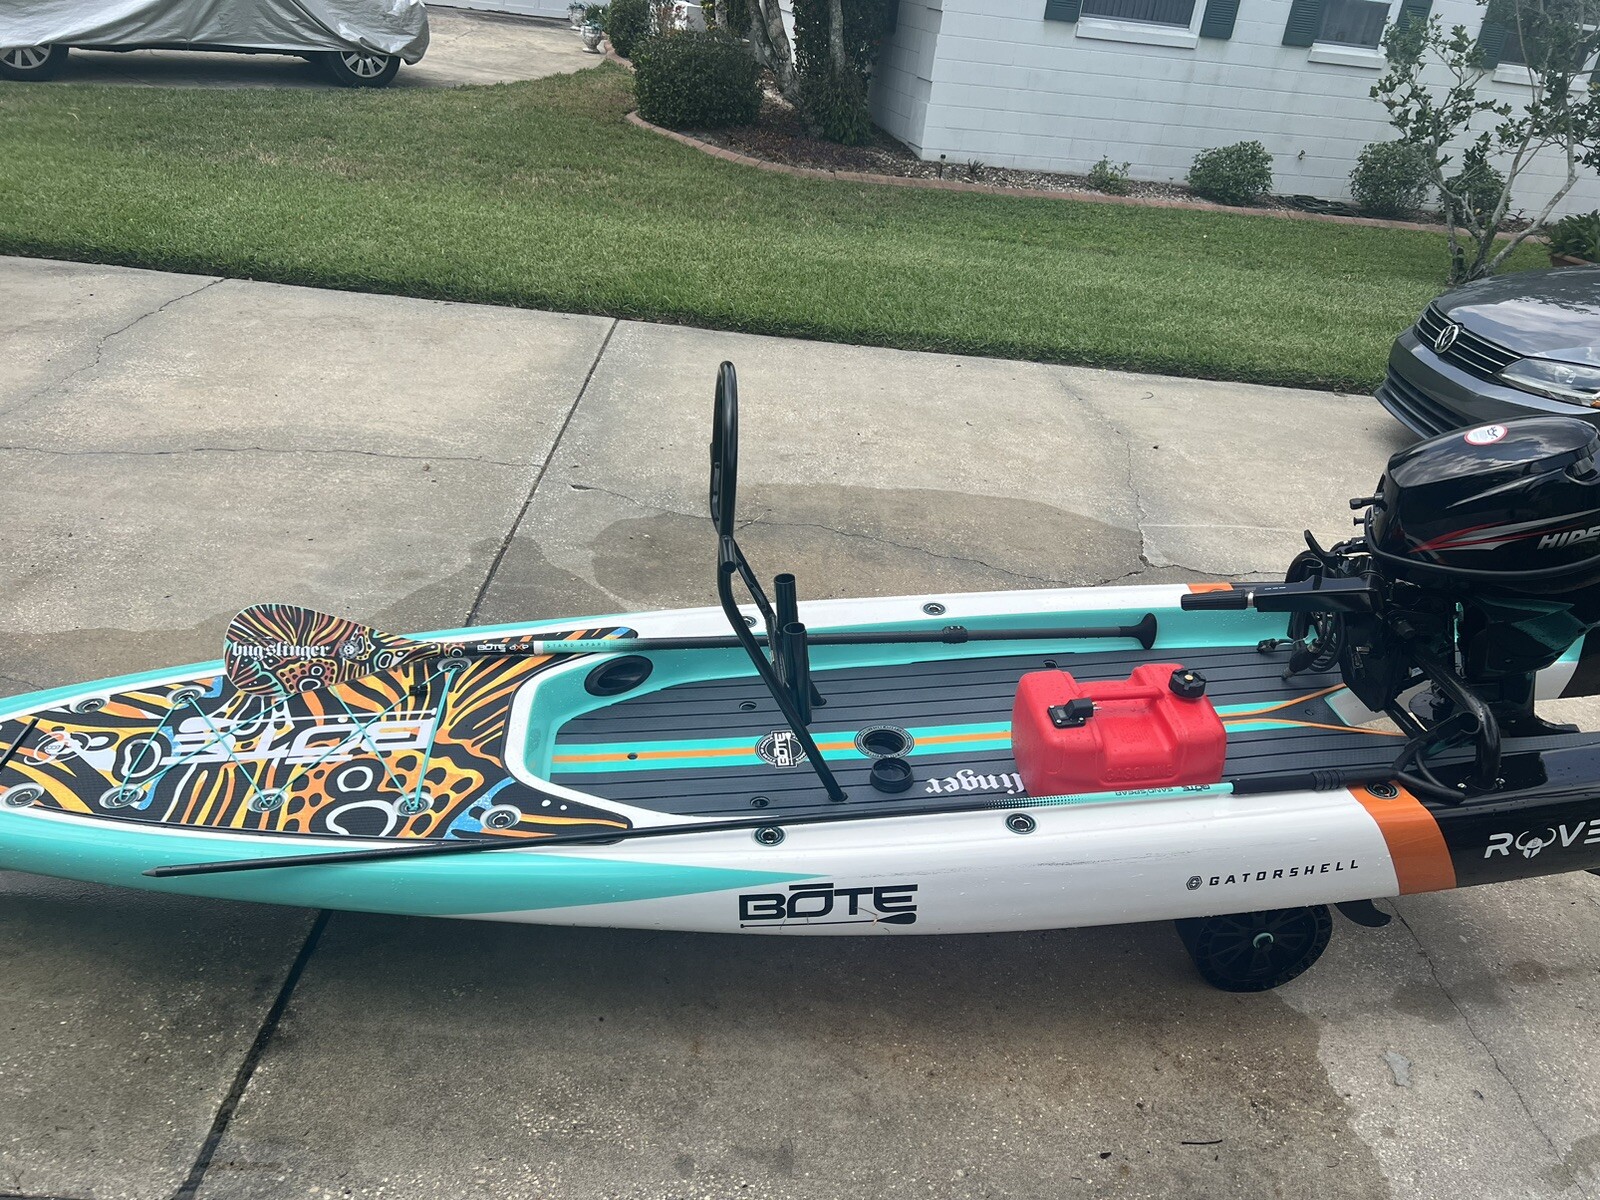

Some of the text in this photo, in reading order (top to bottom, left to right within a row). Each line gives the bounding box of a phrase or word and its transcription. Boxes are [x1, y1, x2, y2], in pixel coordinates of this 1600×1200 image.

[231, 640, 332, 662] bugslinger
[1105, 764, 1174, 782] GASOLINE
[1209, 859, 1359, 886] GATORSHELL
